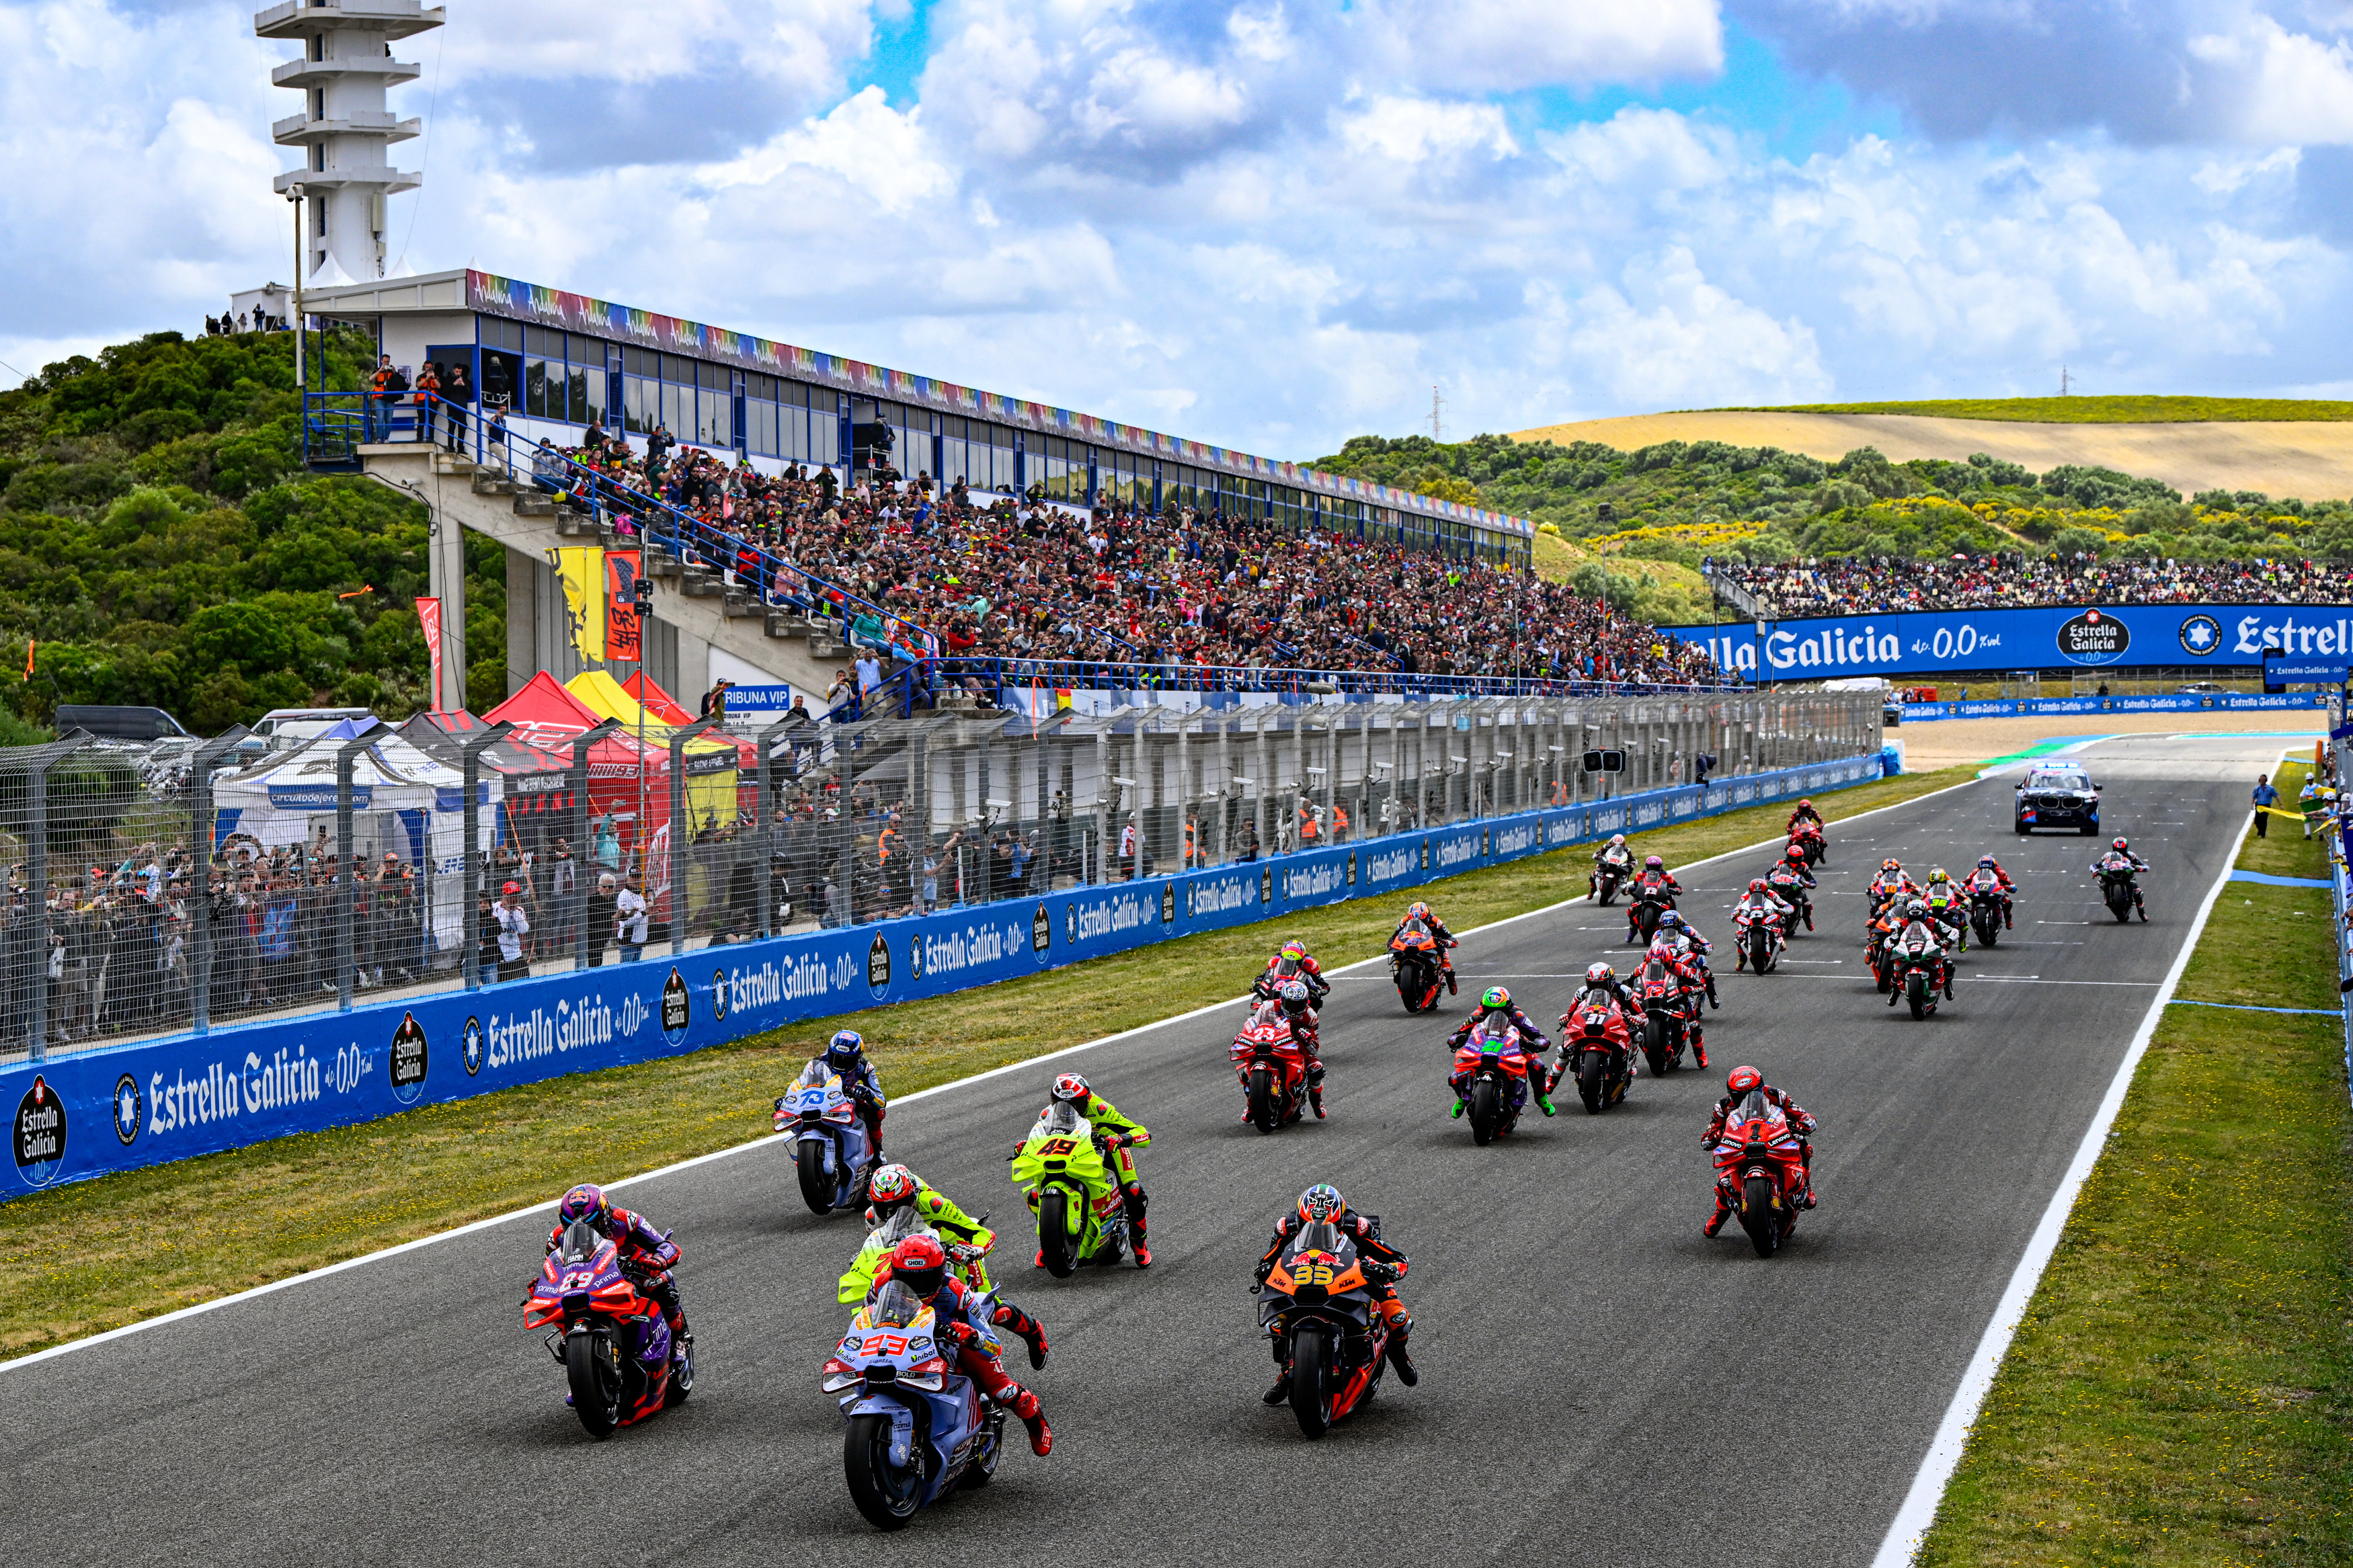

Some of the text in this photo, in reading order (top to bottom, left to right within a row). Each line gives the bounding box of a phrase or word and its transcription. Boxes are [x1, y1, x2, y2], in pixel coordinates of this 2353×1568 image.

[474, 279, 514, 310] Andalucía
[528, 284, 564, 319] Andalucía
[2069, 625, 2118, 640] Estrella
[2233, 616, 2353, 655] Estrel
[1765, 626, 1902, 669] Galicia
[1933, 624, 1977, 659] 0,0
[2070, 636, 2116, 651] Galicia
[2276, 666, 2303, 675] Estrella
[2304, 666, 2329, 675] Galicia
[723, 691, 787, 704] RIBUNA VIP
[2230, 698, 2258, 706] Estrella
[2259, 696, 2286, 706] Galicia
[272, 792, 368, 804] circuitodejereom
[435, 856, 465, 874] JERE
[1195, 880, 1219, 915] Estrella
[1220, 876, 1242, 910] Galicia
[1930, 899, 1948, 907] 36
[1078, 901, 1111, 940] Estrella
[1111, 893, 1139, 932] Galicia
[925, 932, 966, 975] Estrella
[966, 921, 1001, 967] Galicia
[871, 948, 887, 966] Estrella
[872, 963, 887, 983] Galicia
[731, 961, 781, 1014] Estrella
[783, 952, 828, 1001] Galicia
[666, 990, 685, 1007] Estrella
[1644, 987, 1665, 1000] 12
[667, 1007, 685, 1026] Galicia
[1585, 1013, 1607, 1025] 31
[487, 1007, 553, 1069] Estrella
[556, 993, 612, 1053] Galicia
[623, 992, 640, 1038] 0,0
[1254, 1028, 1275, 1040] 23
[395, 1036, 422, 1060] Estrella
[1238, 1037, 1253, 1046] Lenovo
[1273, 1036, 1291, 1046] Lenovo
[1465, 1042, 1480, 1051] prima
[1481, 1040, 1504, 1053] 21
[396, 1055, 421, 1081] Galicia
[149, 1061, 239, 1136] Estrella
[243, 1044, 320, 1114] Galicia
[336, 1042, 360, 1094] 0,0
[799, 1090, 826, 1108] 73
[830, 1098, 844, 1107] Unibat
[22, 1106, 58, 1133] Estrella
[1749, 1124, 1761, 1140] 1
[24, 1130, 56, 1159] Galicia
[1036, 1139, 1078, 1156] 49
[1721, 1138, 1742, 1149] Lenovo
[1768, 1134, 1790, 1147] Lenovo
[568, 1254, 584, 1263] FIAMM
[598, 1249, 616, 1270] PRAMAC
[872, 1251, 894, 1274] 7
[545, 1263, 555, 1280] PRAMAC
[1293, 1266, 1333, 1285] 33
[559, 1272, 596, 1293] 89
[594, 1272, 619, 1288] prima
[1273, 1278, 1286, 1287] KTM
[1339, 1278, 1355, 1289] KTM
[537, 1285, 559, 1294] prima
[602, 1282, 625, 1295] MOTUL
[912, 1307, 933, 1326] Antangin
[859, 1334, 910, 1357] 93
[911, 1337, 928, 1346] Estrella
[913, 1342, 929, 1350] Galicia
[837, 1350, 855, 1363] Unibat
[911, 1350, 935, 1362] Unibat
[947, 1379, 966, 1395] DUCATI
[893, 1421, 910, 1429] azimut
